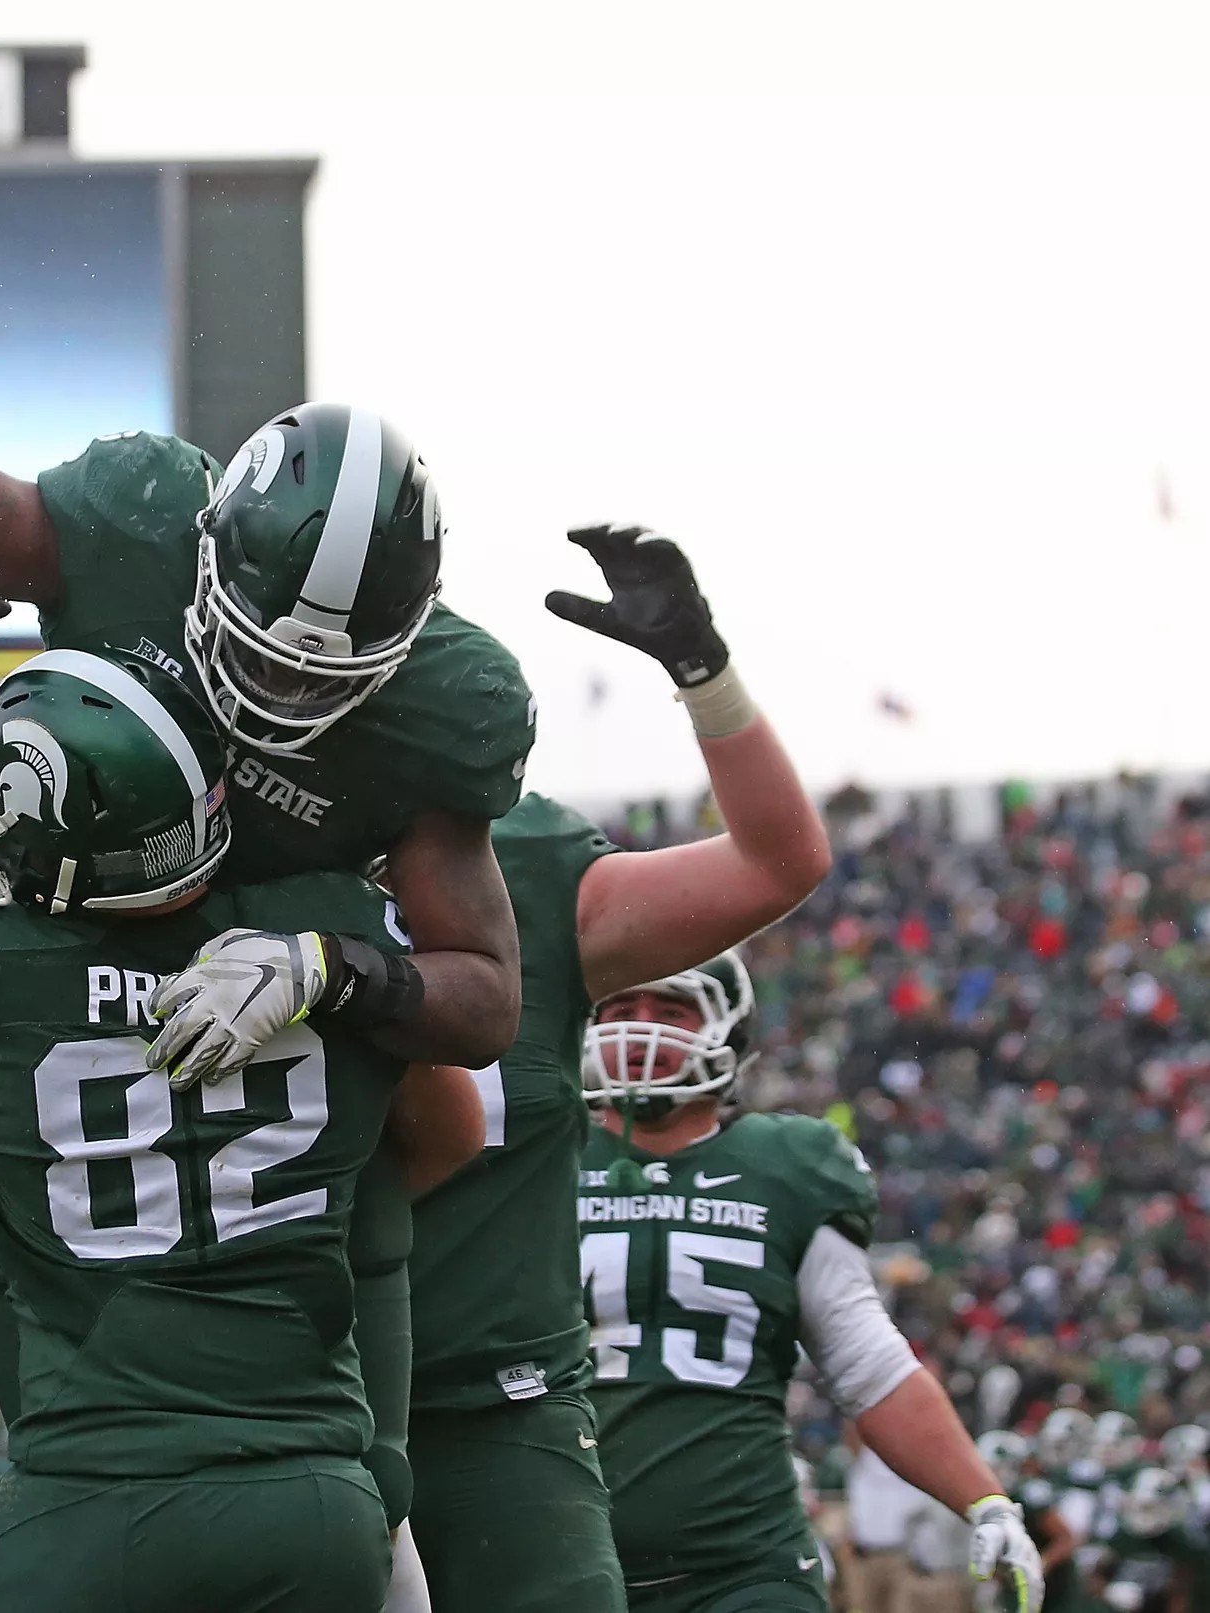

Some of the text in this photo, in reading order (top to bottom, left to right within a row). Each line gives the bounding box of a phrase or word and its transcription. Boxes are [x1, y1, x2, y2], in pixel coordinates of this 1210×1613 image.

[234, 757, 333, 827] STATE
[87, 965, 170, 1026] PR
[34, 1022, 329, 1260] 82
[577, 1193, 769, 1234] ICHIGAN STATE
[579, 1231, 766, 1388] 45
[507, 1368, 524, 1380] 46
